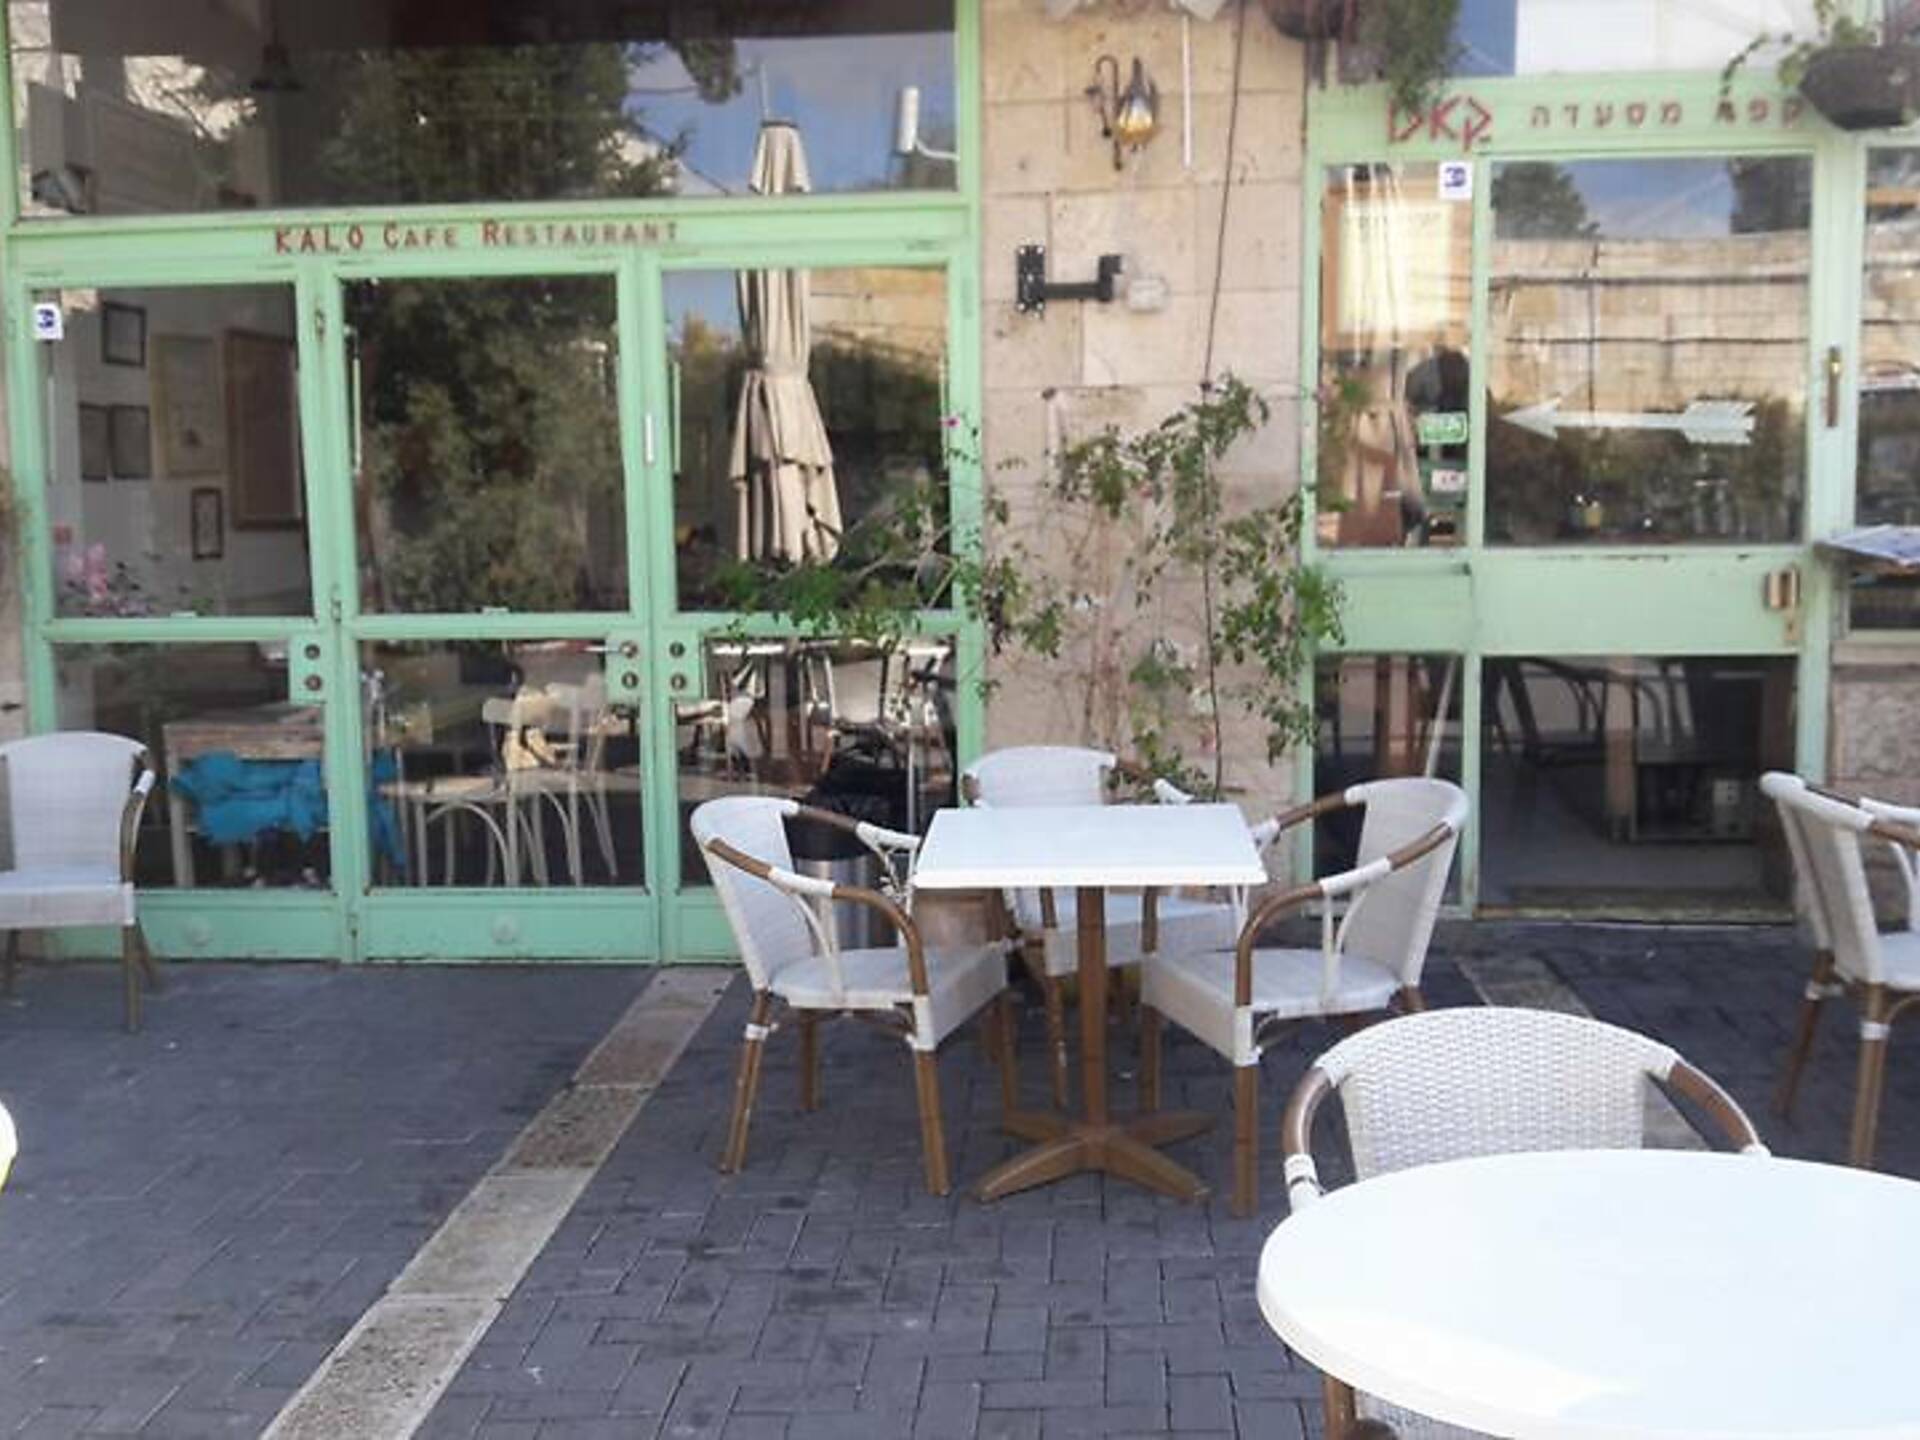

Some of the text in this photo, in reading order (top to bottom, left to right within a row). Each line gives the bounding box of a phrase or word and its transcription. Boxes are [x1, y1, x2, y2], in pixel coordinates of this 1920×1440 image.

[1529, 101, 1683, 127] מסעדה
[275, 225, 363, 254] KALO
[482, 219, 678, 247] RESTAURANT
